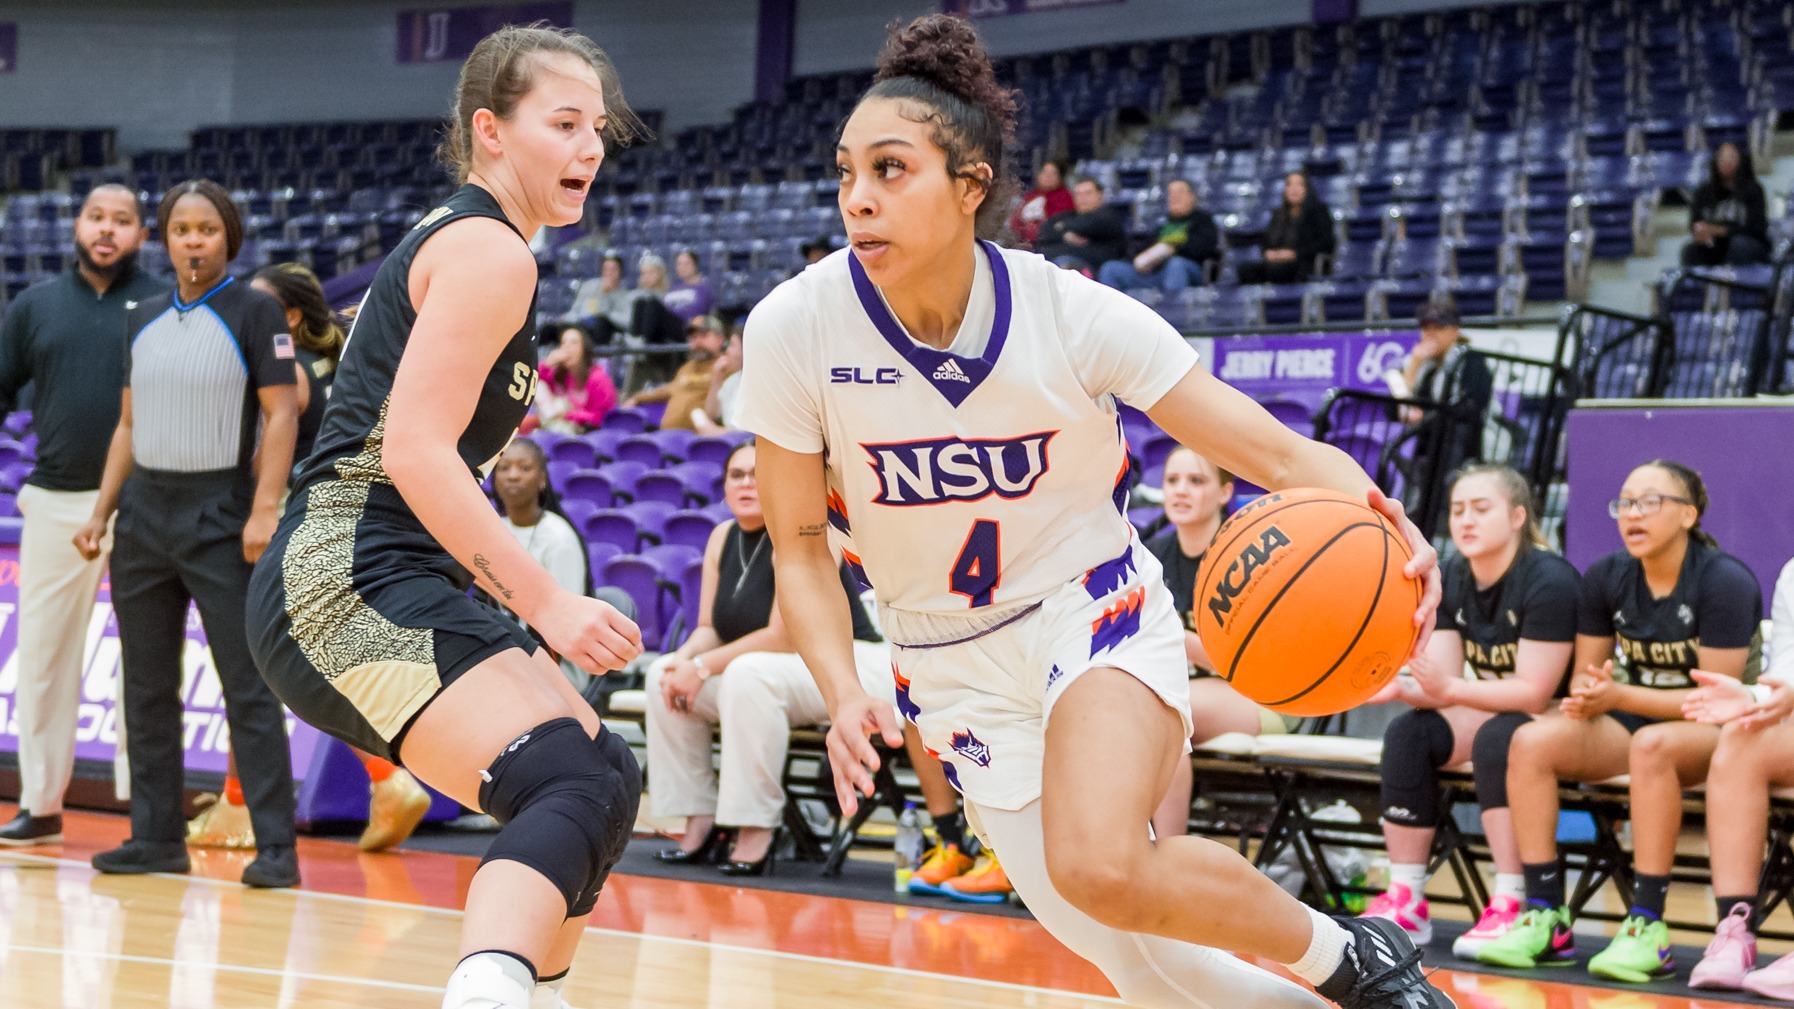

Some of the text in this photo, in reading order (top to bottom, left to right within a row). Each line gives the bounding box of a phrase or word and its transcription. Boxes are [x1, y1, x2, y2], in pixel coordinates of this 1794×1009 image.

[831, 367, 897, 385] SLC
[933, 370, 971, 384] adidas
[1275, 348, 1335, 379] PIERCE
[877, 438, 1043, 502] NSU
[949, 518, 1001, 608] 4
[1208, 525, 1291, 629] NCAA
[1616, 632, 1646, 662] PA
